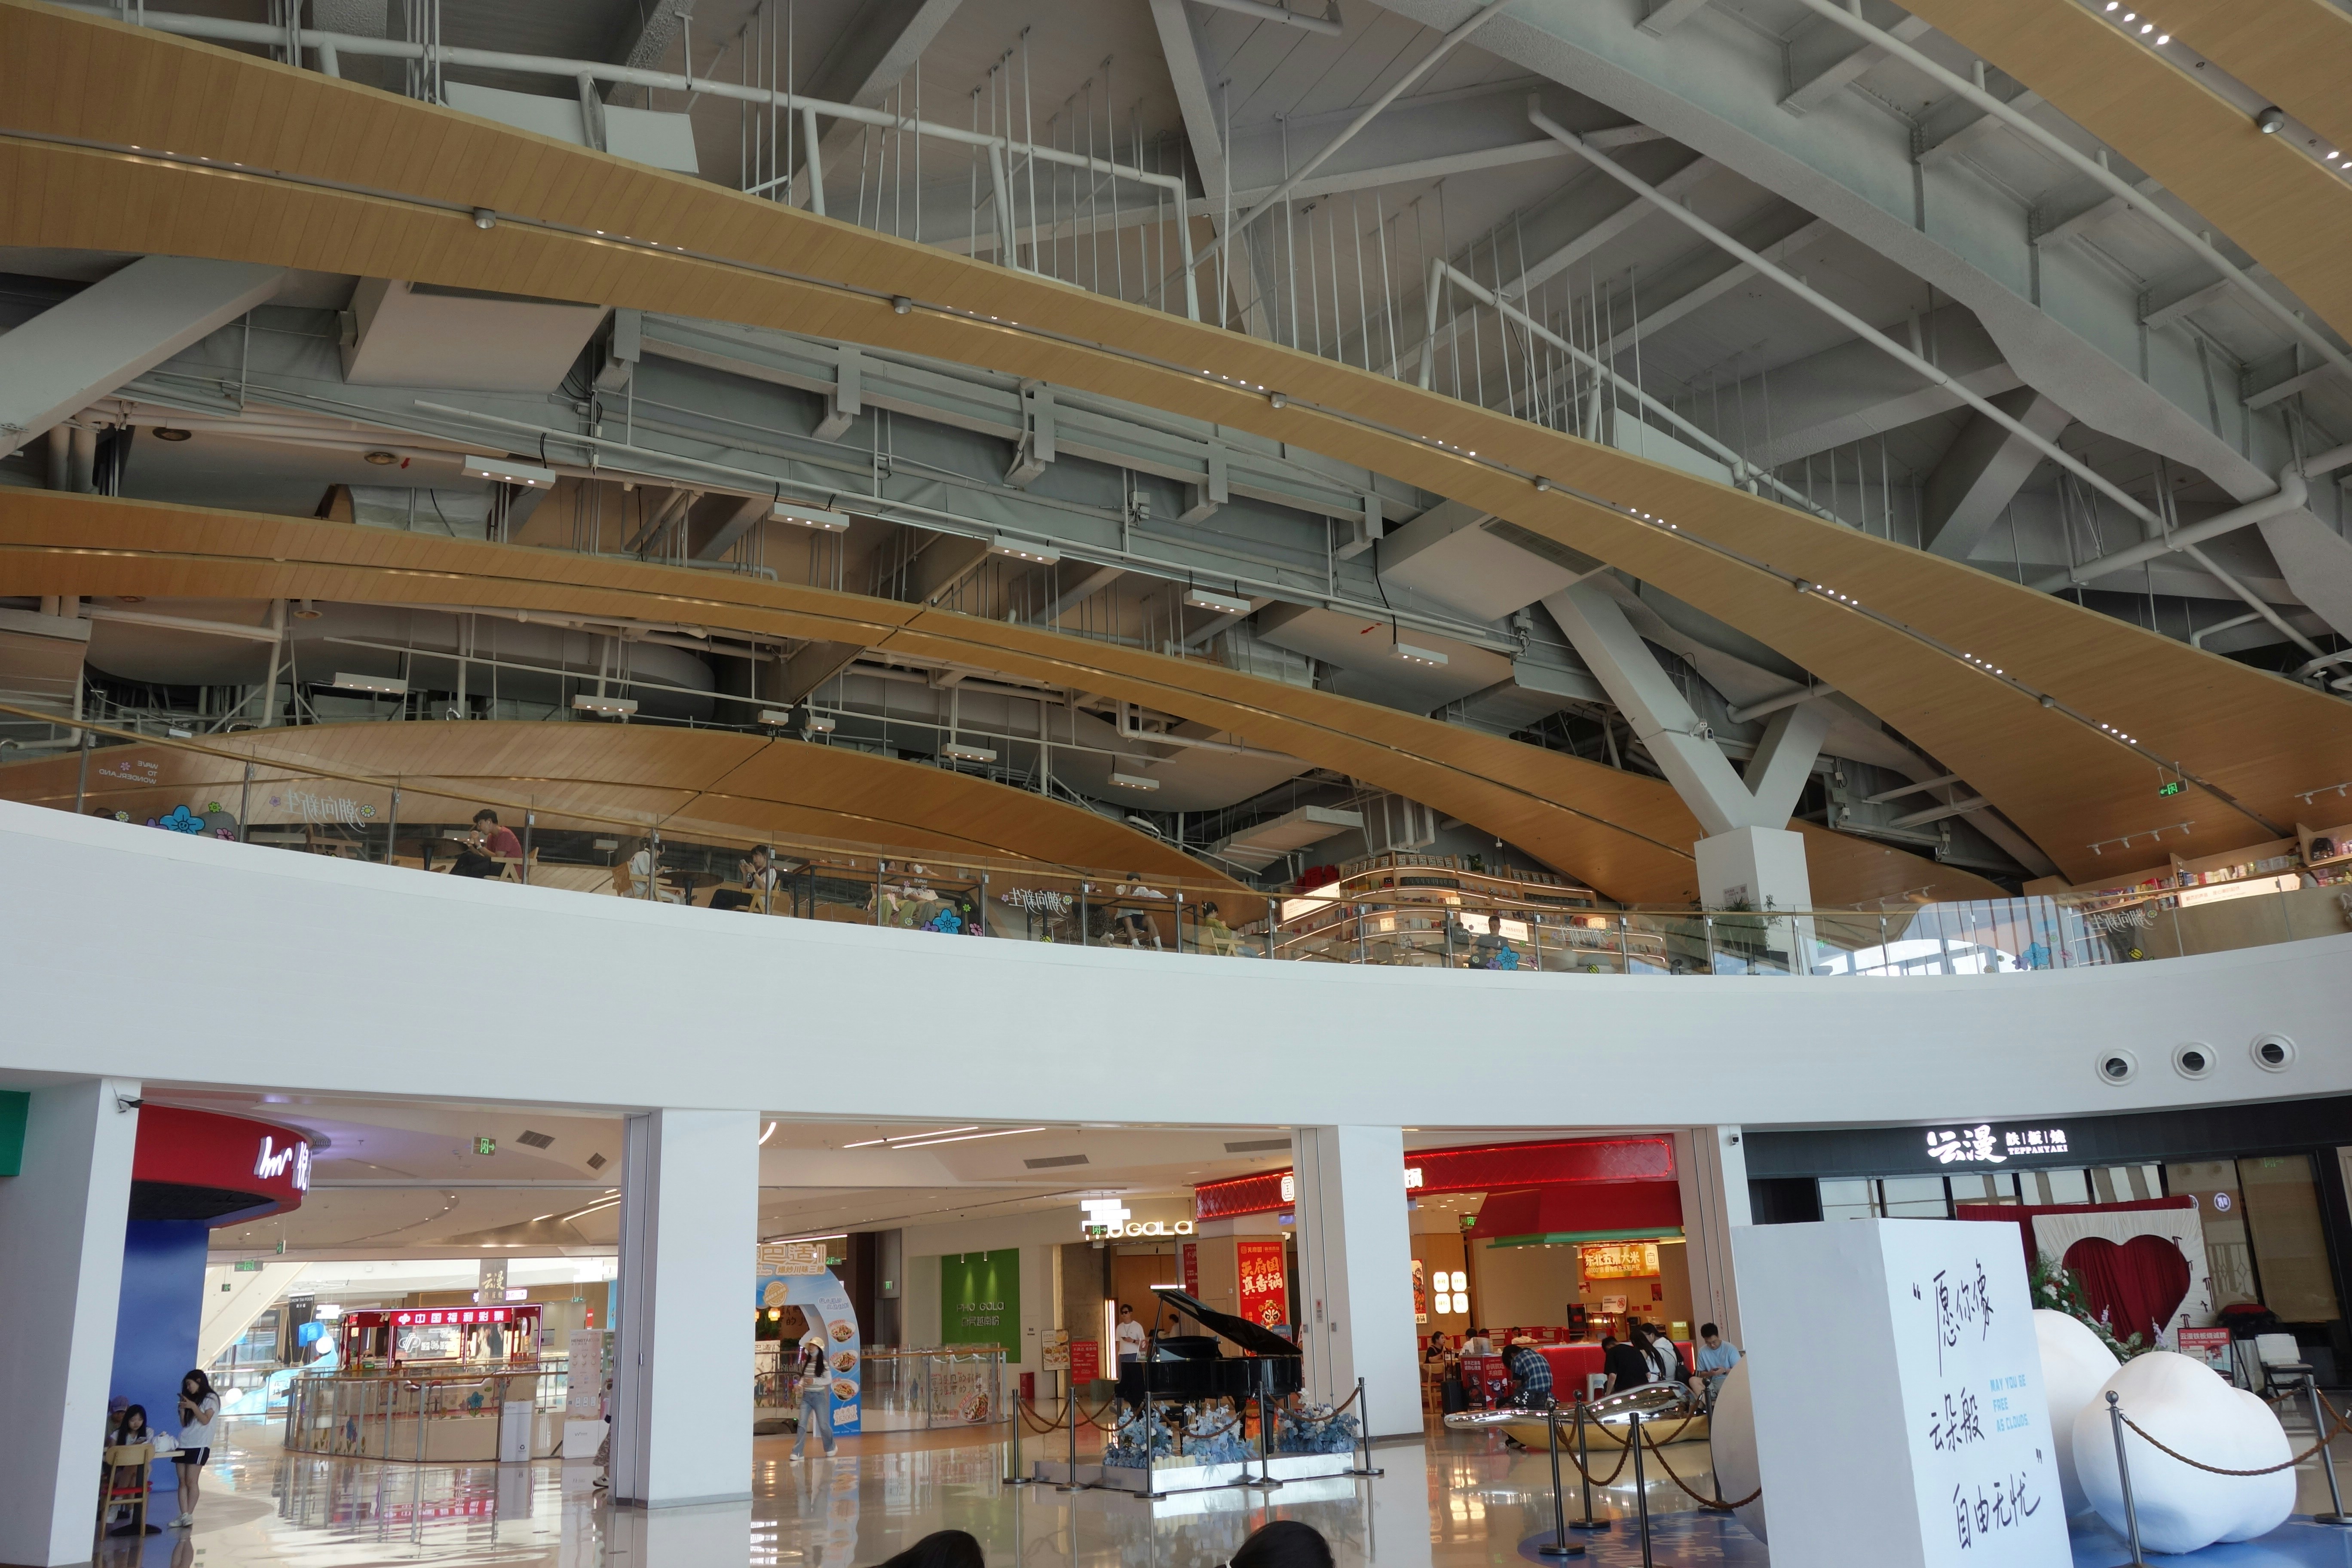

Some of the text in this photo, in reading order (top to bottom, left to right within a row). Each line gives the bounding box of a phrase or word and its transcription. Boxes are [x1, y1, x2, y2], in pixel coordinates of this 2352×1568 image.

[1927, 1125, 2007, 1164] 云漫
[2008, 1144, 2068, 1155] TEPPANYAKI
[1240, 1256, 1280, 1278] 天府国
[1585, 1251, 1640, 1267] 东北五常大米
[481, 1271, 505, 1290] 云漫
[1242, 1272, 1283, 1295] 真香锅
[957, 1303, 975, 1311] PHO
[414, 1311, 505, 1324] 中国福利彩票
[1990, 1374, 2026, 1392] MAY YOU BE
[1993, 1397, 2009, 1412] FREE
[1929, 1387, 1985, 1452] 云朵般
[1997, 1418, 2005, 1433] AS
